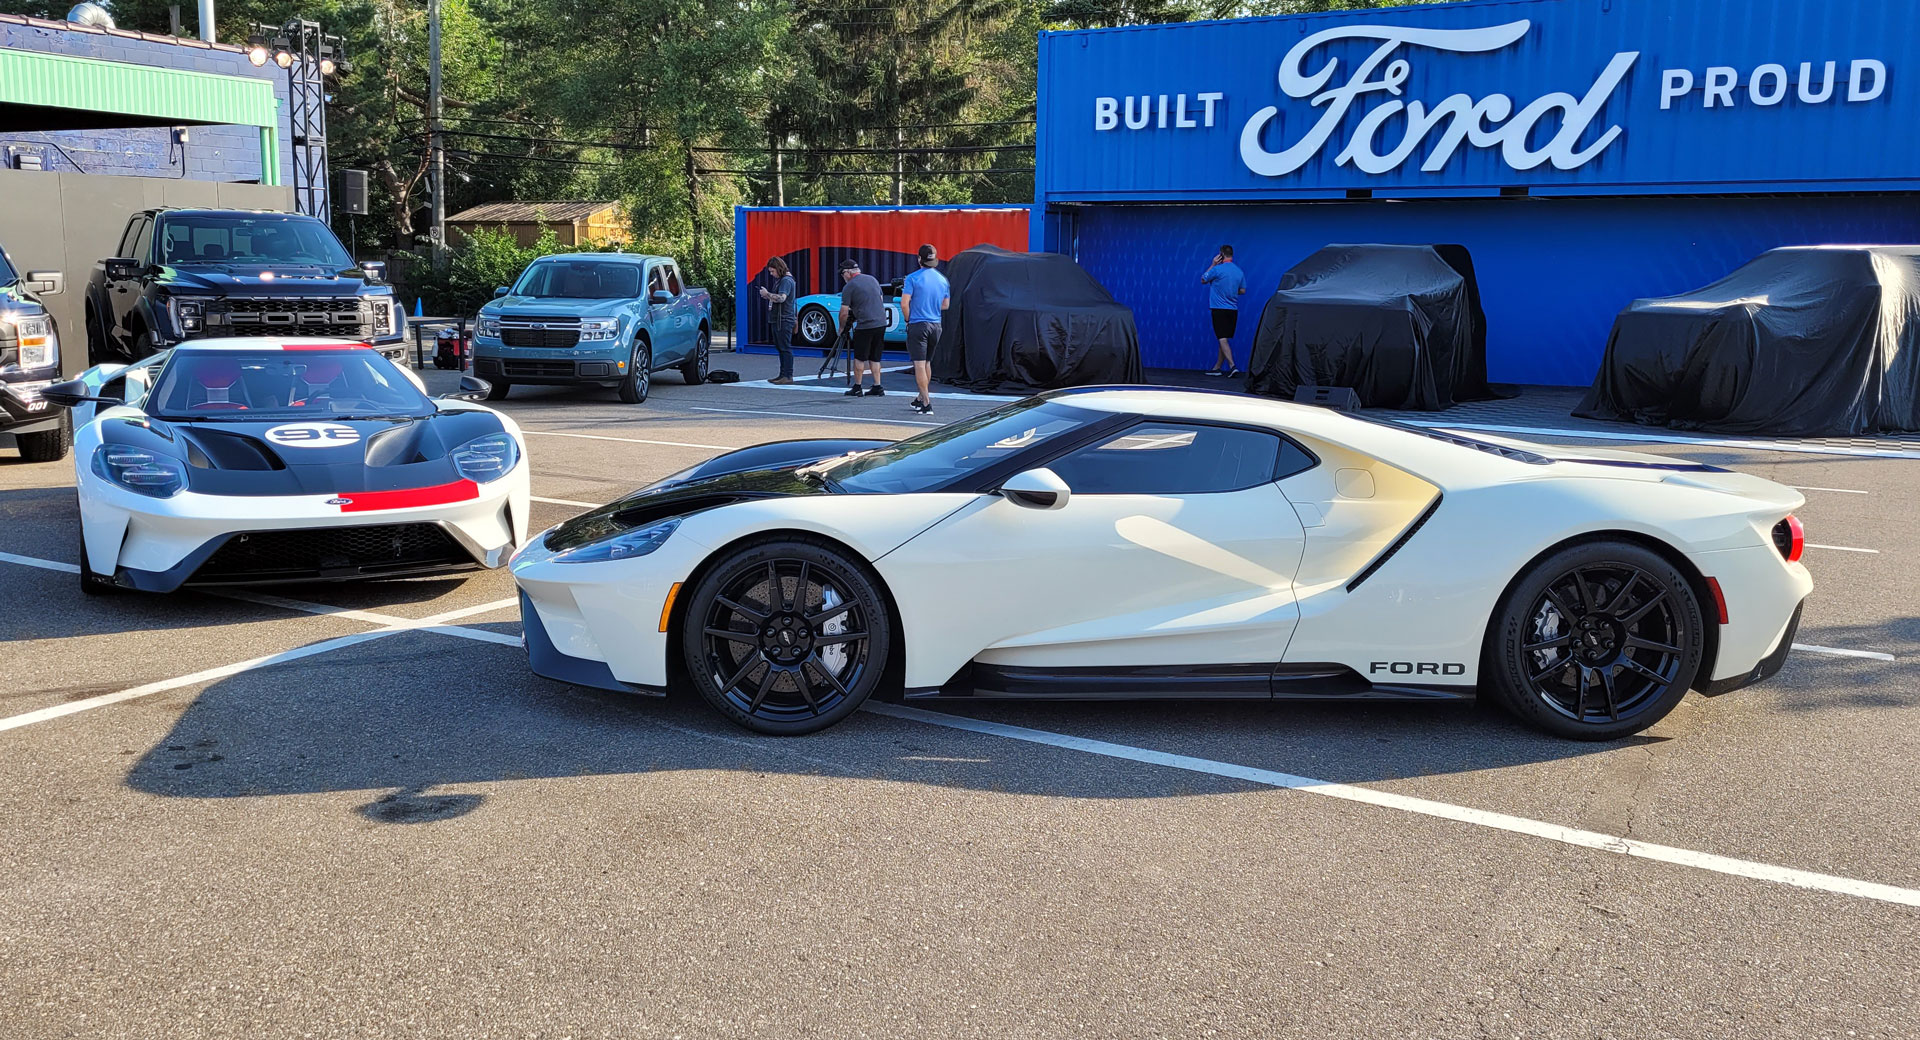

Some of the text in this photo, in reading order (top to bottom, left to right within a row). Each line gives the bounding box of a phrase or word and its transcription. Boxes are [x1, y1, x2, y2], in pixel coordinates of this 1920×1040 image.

[1095, 19, 1887, 177] BUILT Ford PROUD
[224, 312, 364, 325] FORD
[28, 401, 48, 411] 001
[1370, 661, 1466, 676] FORD
